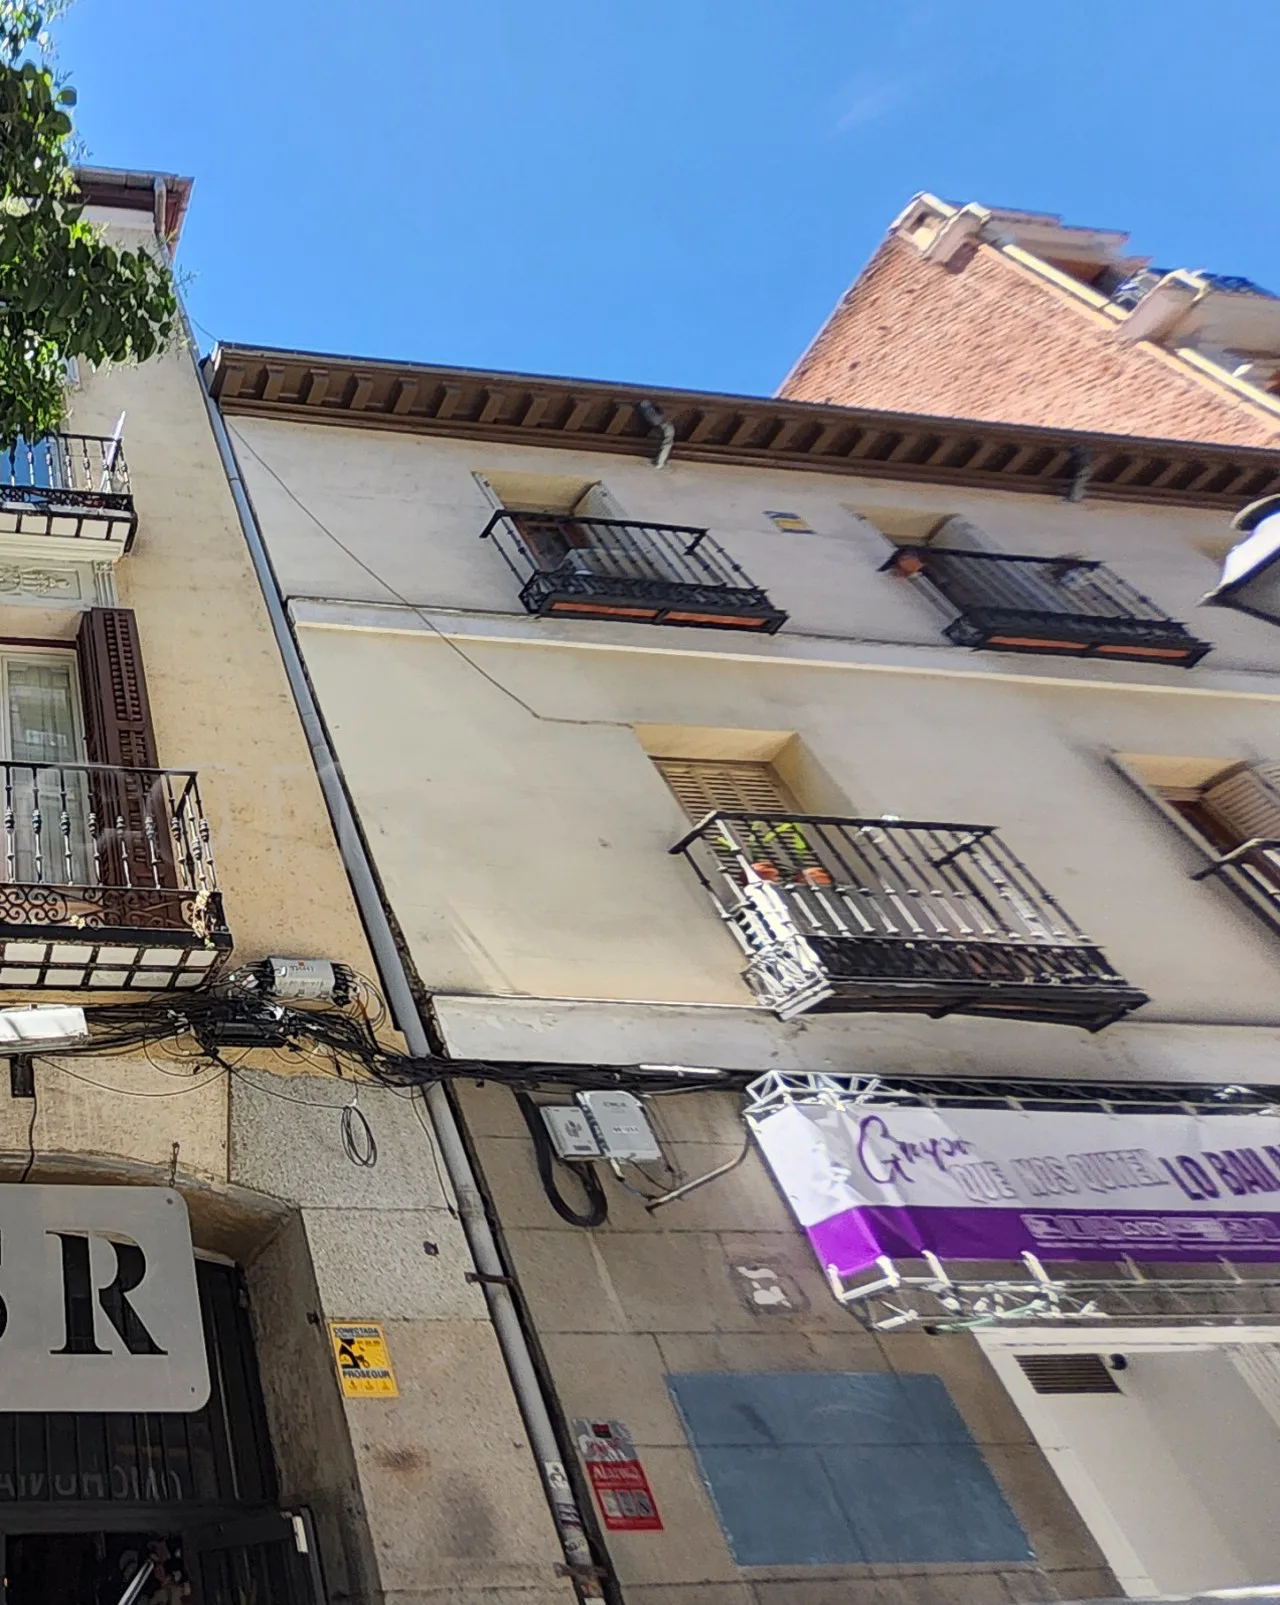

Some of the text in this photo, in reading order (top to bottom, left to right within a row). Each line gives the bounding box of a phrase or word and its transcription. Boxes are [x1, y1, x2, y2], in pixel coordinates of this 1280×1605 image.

[949, 1161, 1018, 1203] QUE
[1009, 1156, 1080, 1197] NOS
[1158, 1155, 1220, 1200] LO
